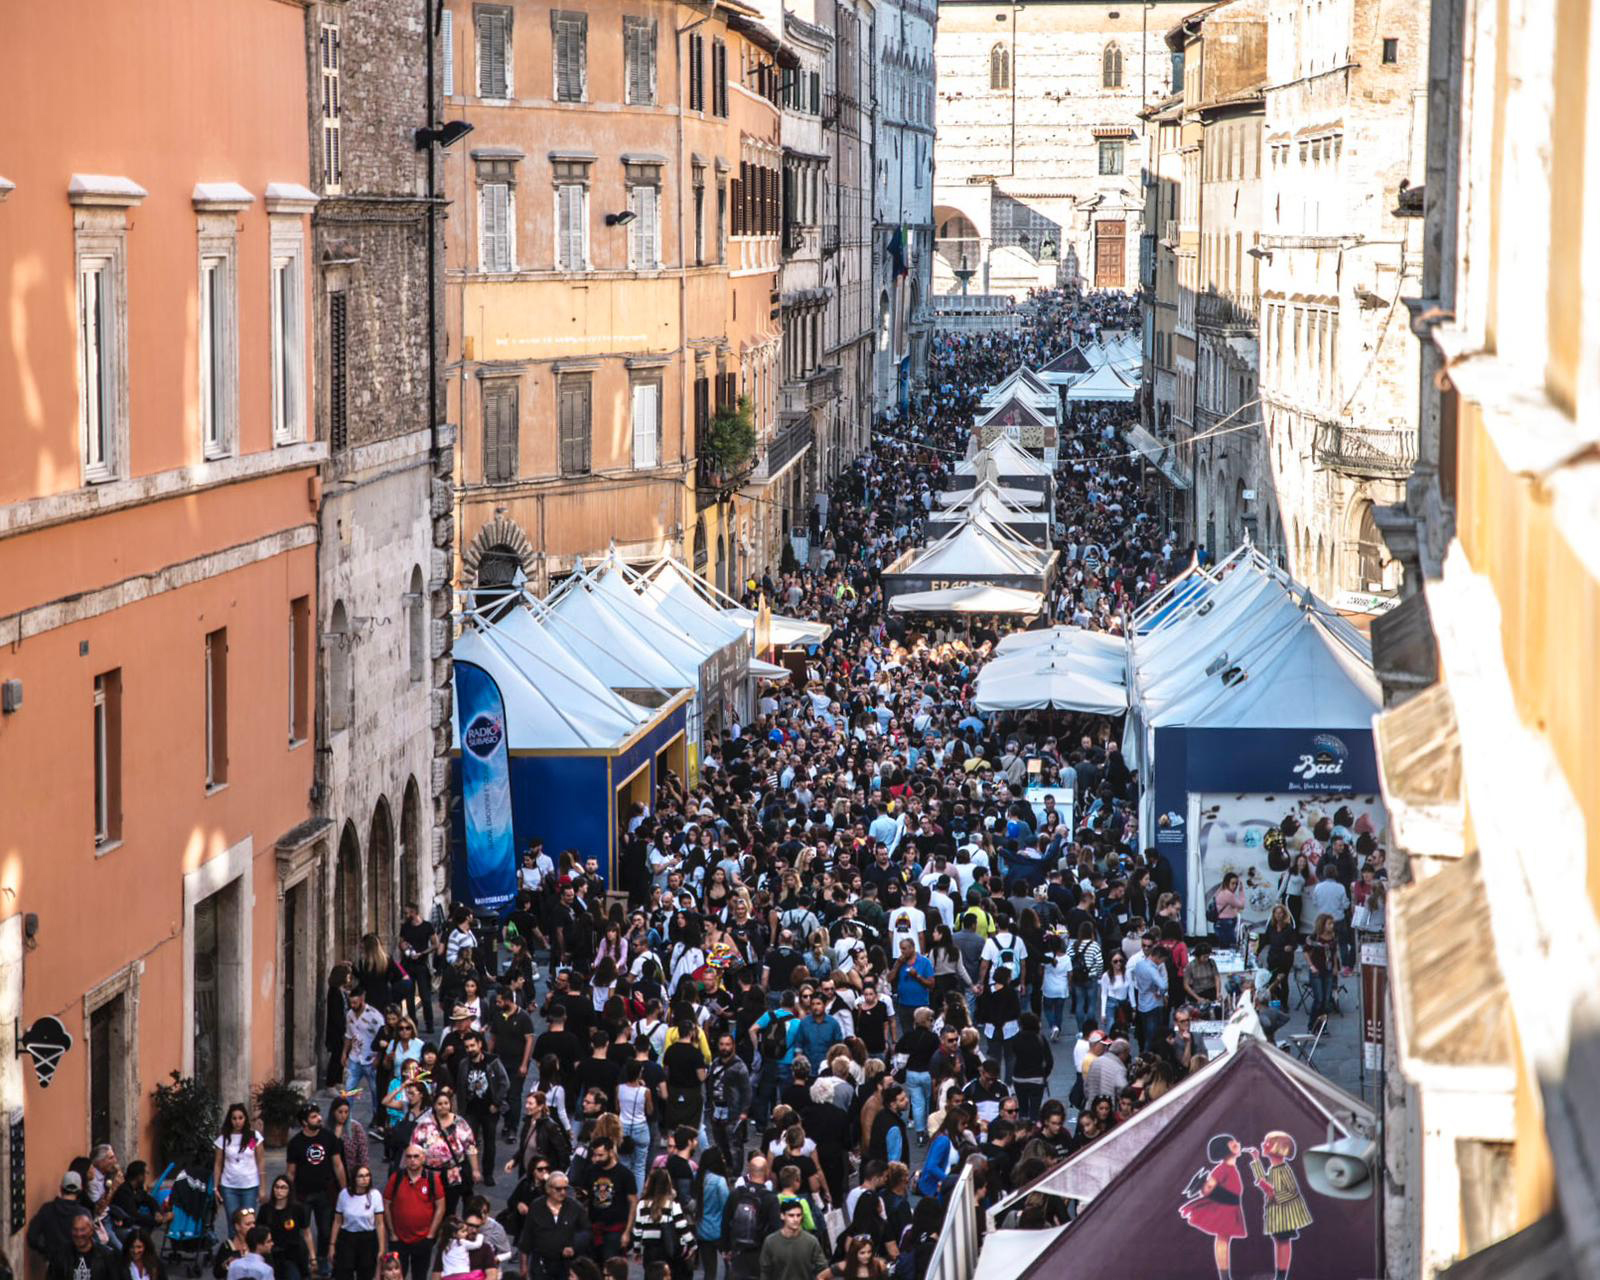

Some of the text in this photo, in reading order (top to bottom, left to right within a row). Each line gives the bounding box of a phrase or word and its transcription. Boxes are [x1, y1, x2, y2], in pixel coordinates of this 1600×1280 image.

[469, 726, 498, 738] RADIO
[469, 735, 498, 746] SUBASIO
[1293, 754, 1344, 780] Baci
